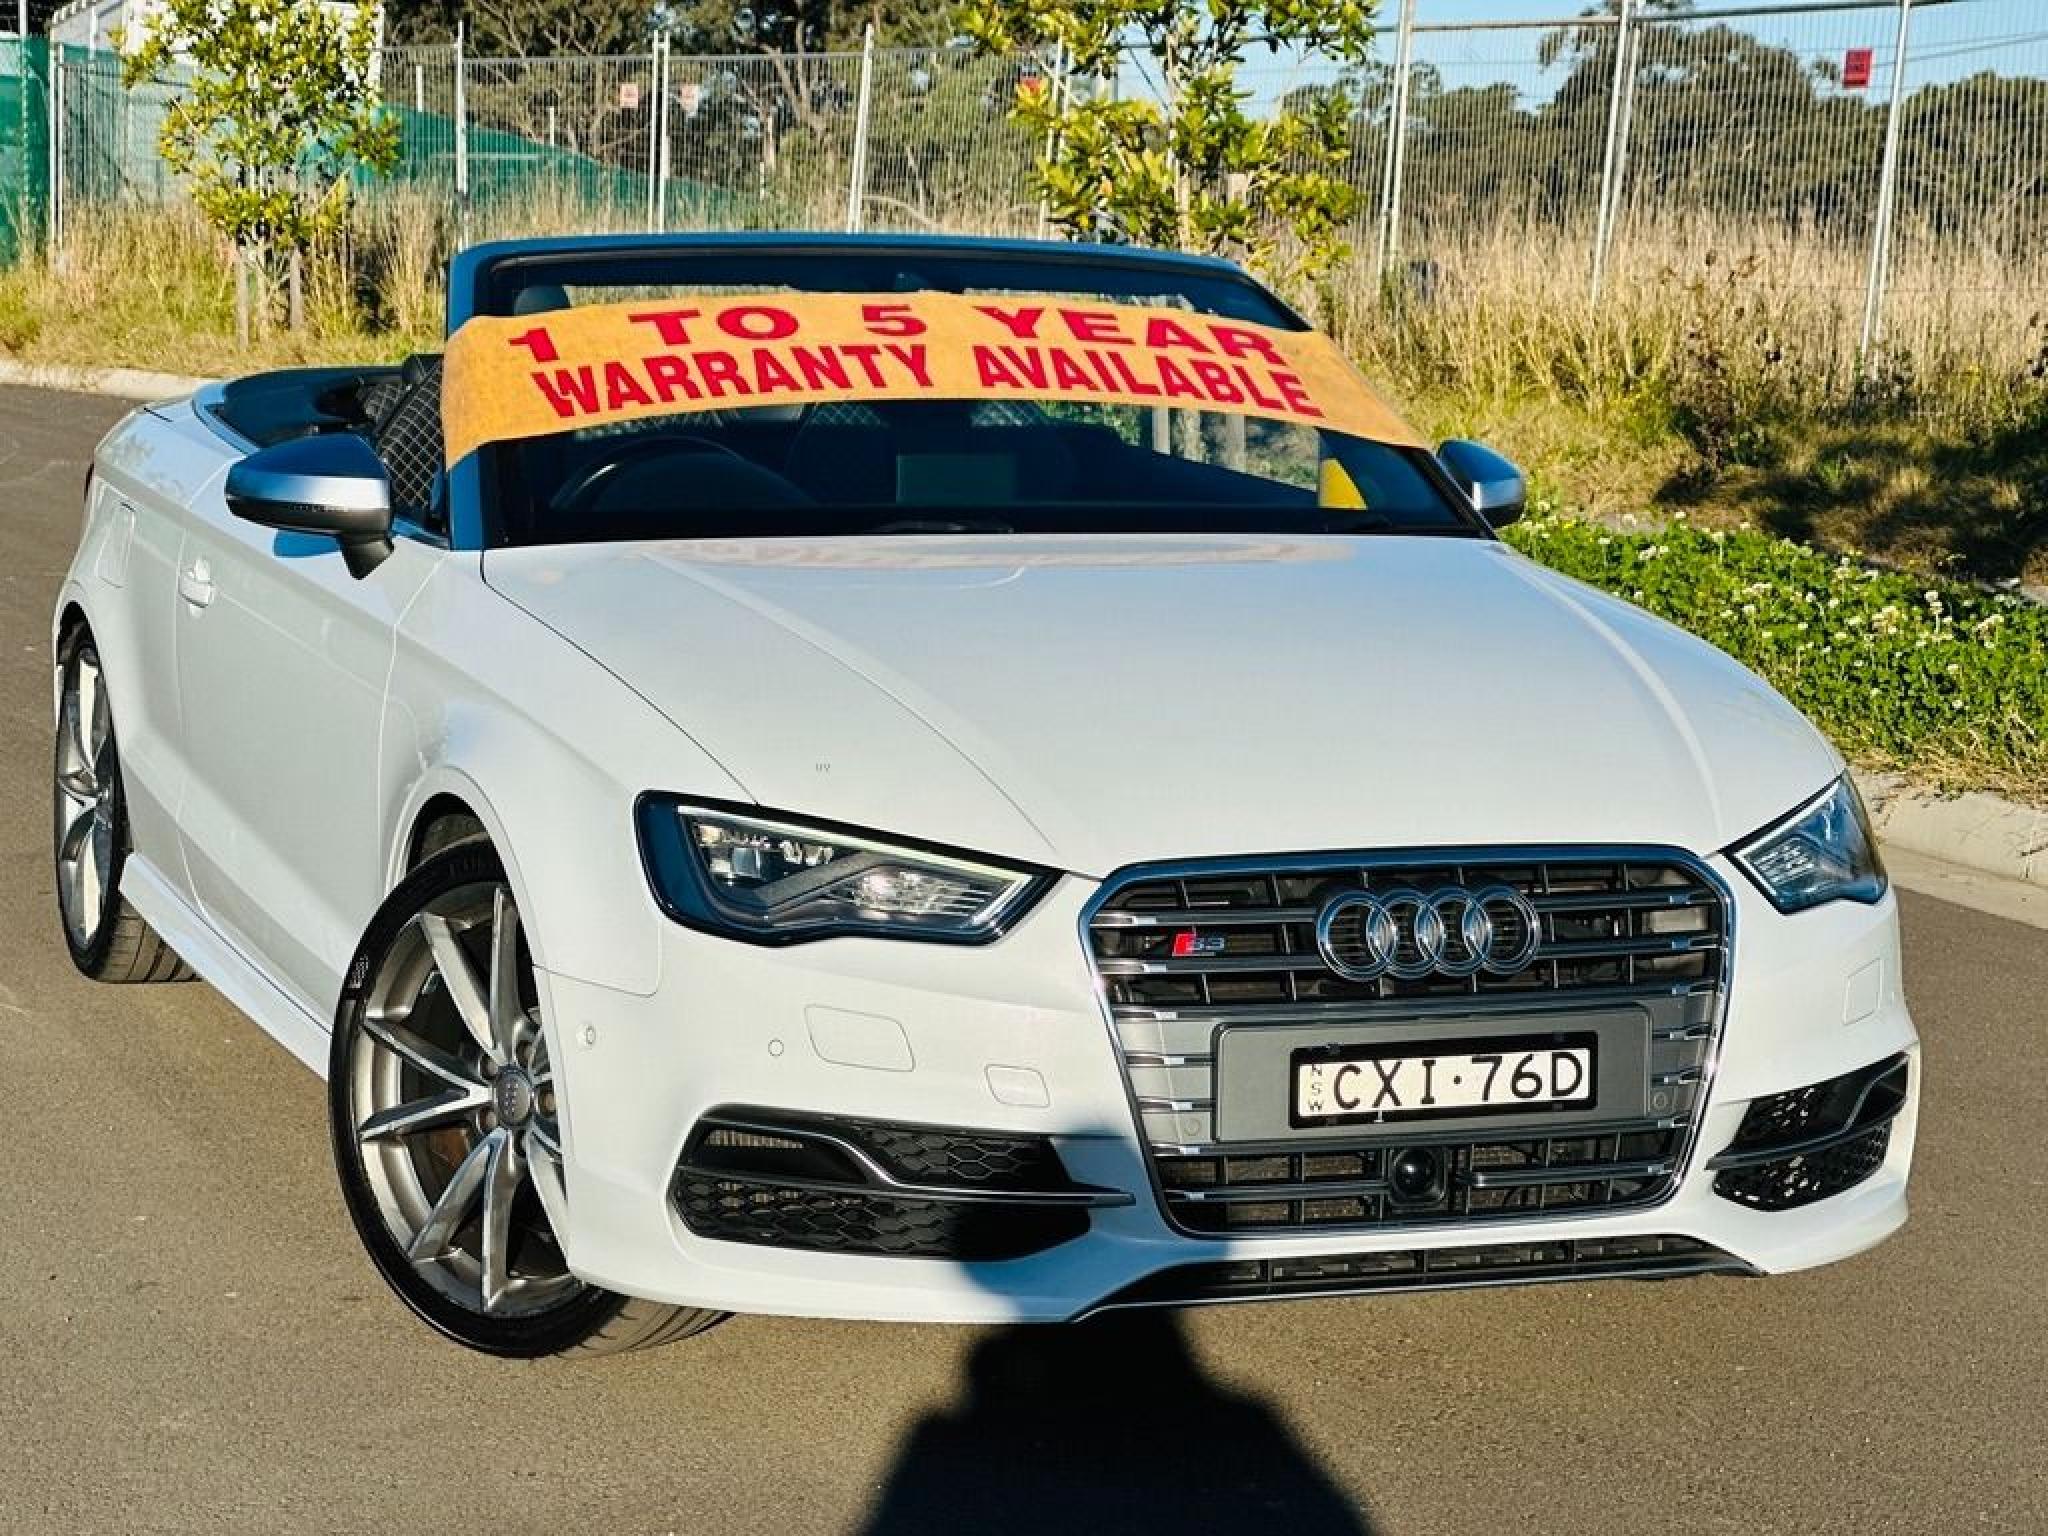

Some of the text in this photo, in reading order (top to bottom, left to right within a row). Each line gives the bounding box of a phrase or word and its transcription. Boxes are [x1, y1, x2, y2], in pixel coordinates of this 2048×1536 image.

[508, 304, 1288, 367] 1 TO 5 YEAR
[530, 343, 1325, 418] WARRANTY AVAILABLE
